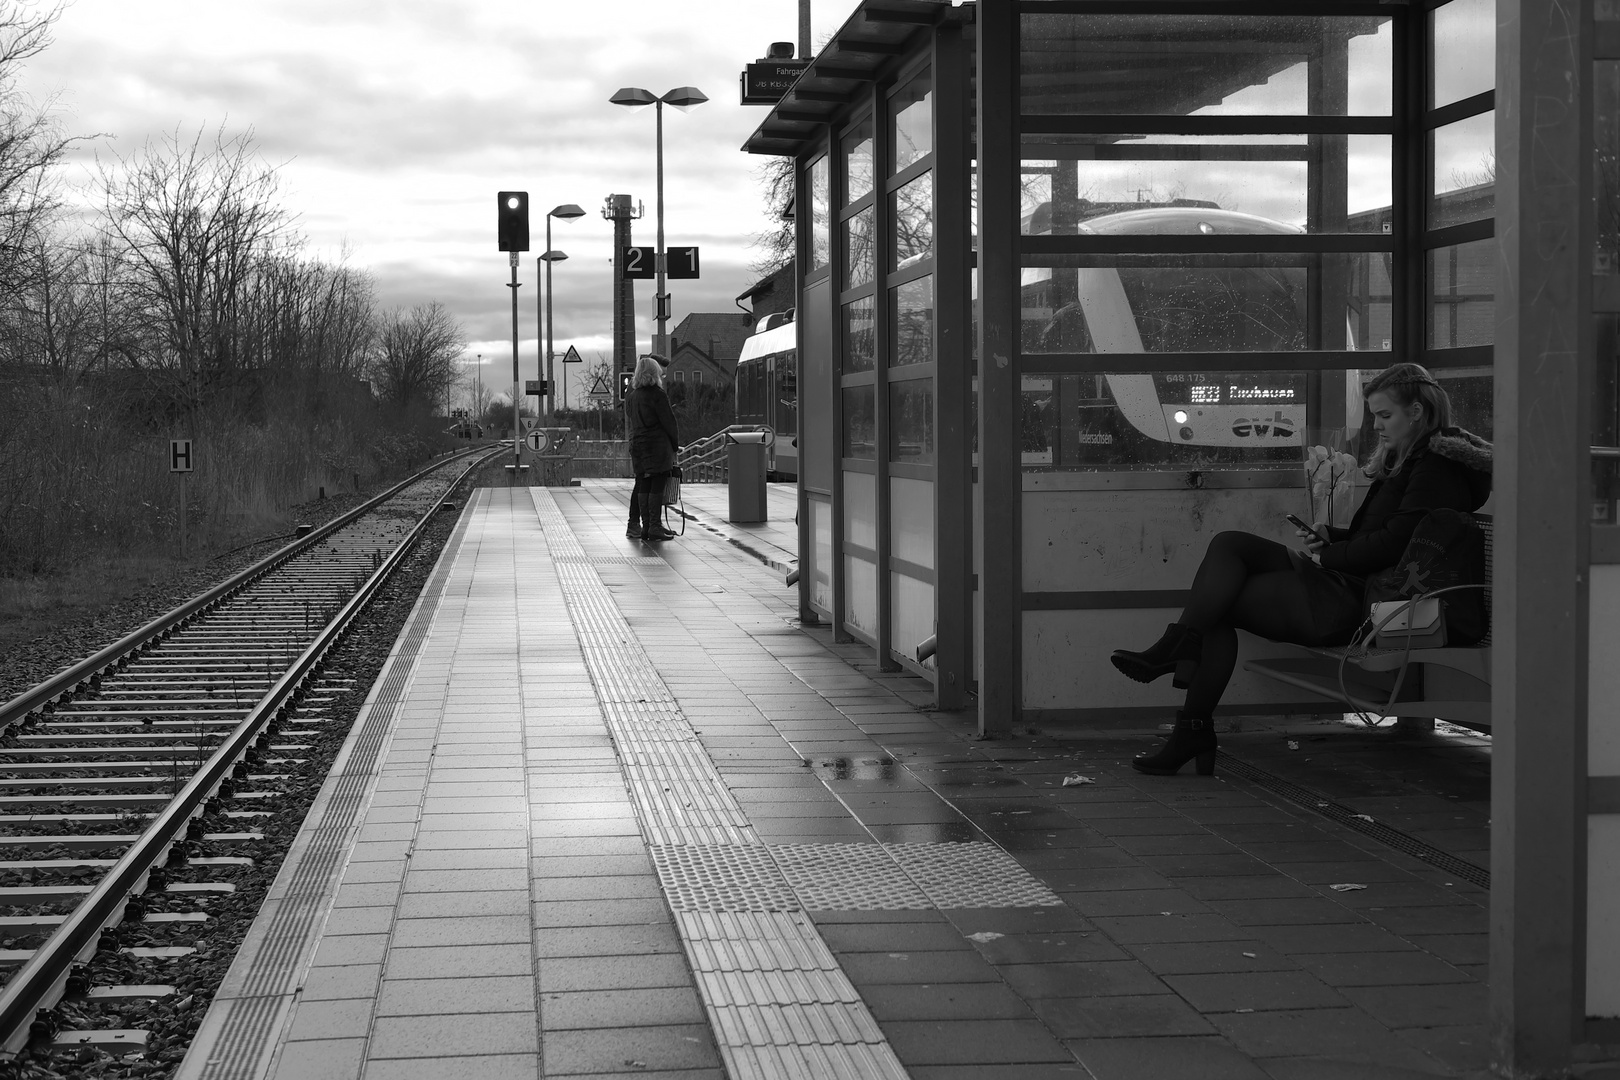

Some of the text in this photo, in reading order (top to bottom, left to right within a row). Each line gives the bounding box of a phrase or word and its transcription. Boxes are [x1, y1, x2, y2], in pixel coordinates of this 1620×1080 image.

[626, 247, 643, 272] 2
[685, 247, 696, 272] 1
[1166, 373, 1206, 383] 648 175
[527, 420, 532, 428] 6
[1231, 411, 1294, 438] evb
[172, 442, 191, 469] H
